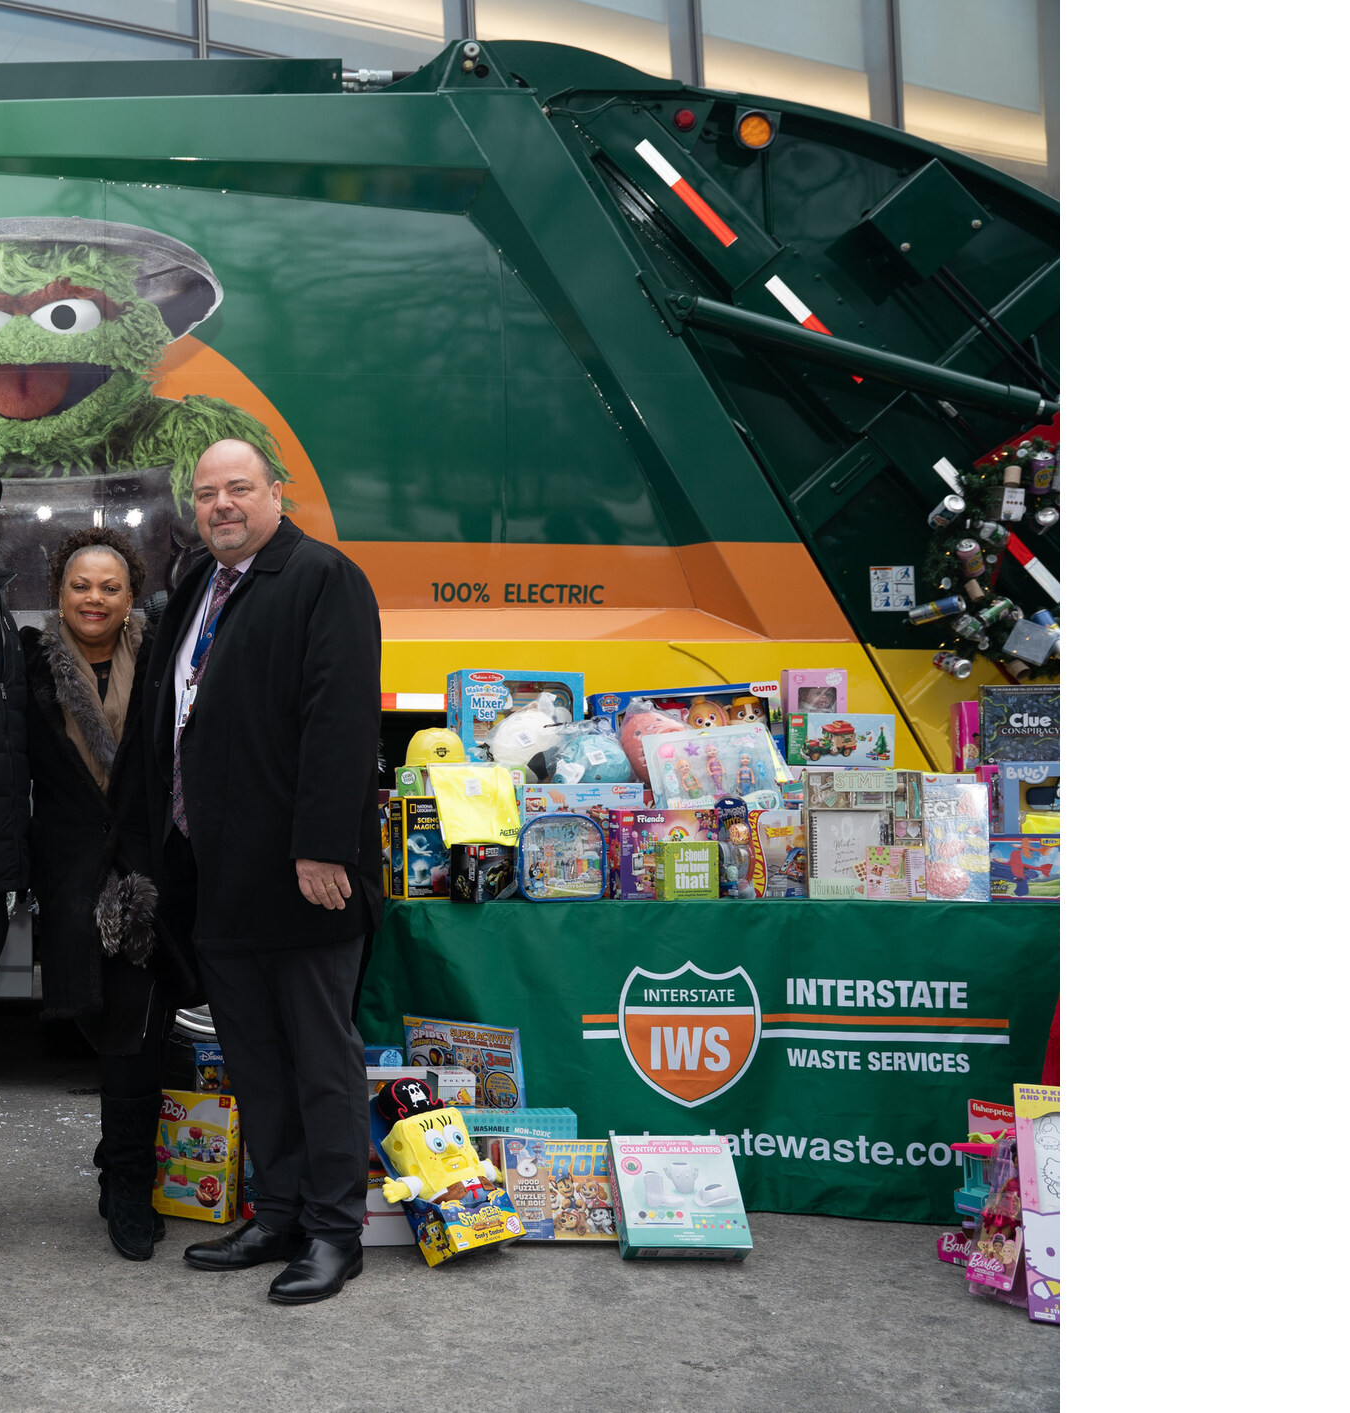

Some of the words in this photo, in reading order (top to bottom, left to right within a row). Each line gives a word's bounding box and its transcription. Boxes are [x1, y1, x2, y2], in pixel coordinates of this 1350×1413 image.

[432, 582, 490, 603] 100%
[504, 583, 605, 605] ELECTRIC
[466, 685, 508, 695] Make-a-Cake
[752, 685, 778, 693] GUND
[472, 697, 503, 709] Mixer
[598, 697, 621, 707] PAW
[479, 709, 494, 719] Set
[1009, 713, 1052, 728] Clue
[1001, 727, 1060, 736] CONSPIRACY
[836, 773, 884, 788] STMT
[637, 814, 665, 823] Friends
[684, 848, 709, 862] should
[674, 862, 689, 873] have
[690, 862, 709, 873] known
[675, 873, 709, 889] that!
[812, 884, 855, 895] JOURNALING
[643, 987, 736, 1003] INTERSTATE
[786, 978, 968, 1009] INTERSTATE
[412, 1028, 448, 1040] SPIDEY
[450, 1028, 476, 1040] SUPER
[476, 1031, 512, 1044] ACTIVITY
[385, 1050, 398, 1058] 24
[650, 1026, 731, 1072] IWS
[485, 1053, 495, 1067] 3
[787, 1048, 862, 1070] WASTE
[867, 1052, 970, 1073] SERVICES
[220, 1098, 229, 1106] 3+
[972, 1102, 1013, 1118] fisher-price
[473, 1125, 510, 1133] WASHABLE
[514, 1127, 551, 1138] NON-TOXIC
[621, 1146, 658, 1154] COUNTRY
[681, 1146, 722, 1154] PLANTERS
[517, 1157, 538, 1178] 6
[969, 1252, 1003, 1272] Barbie
